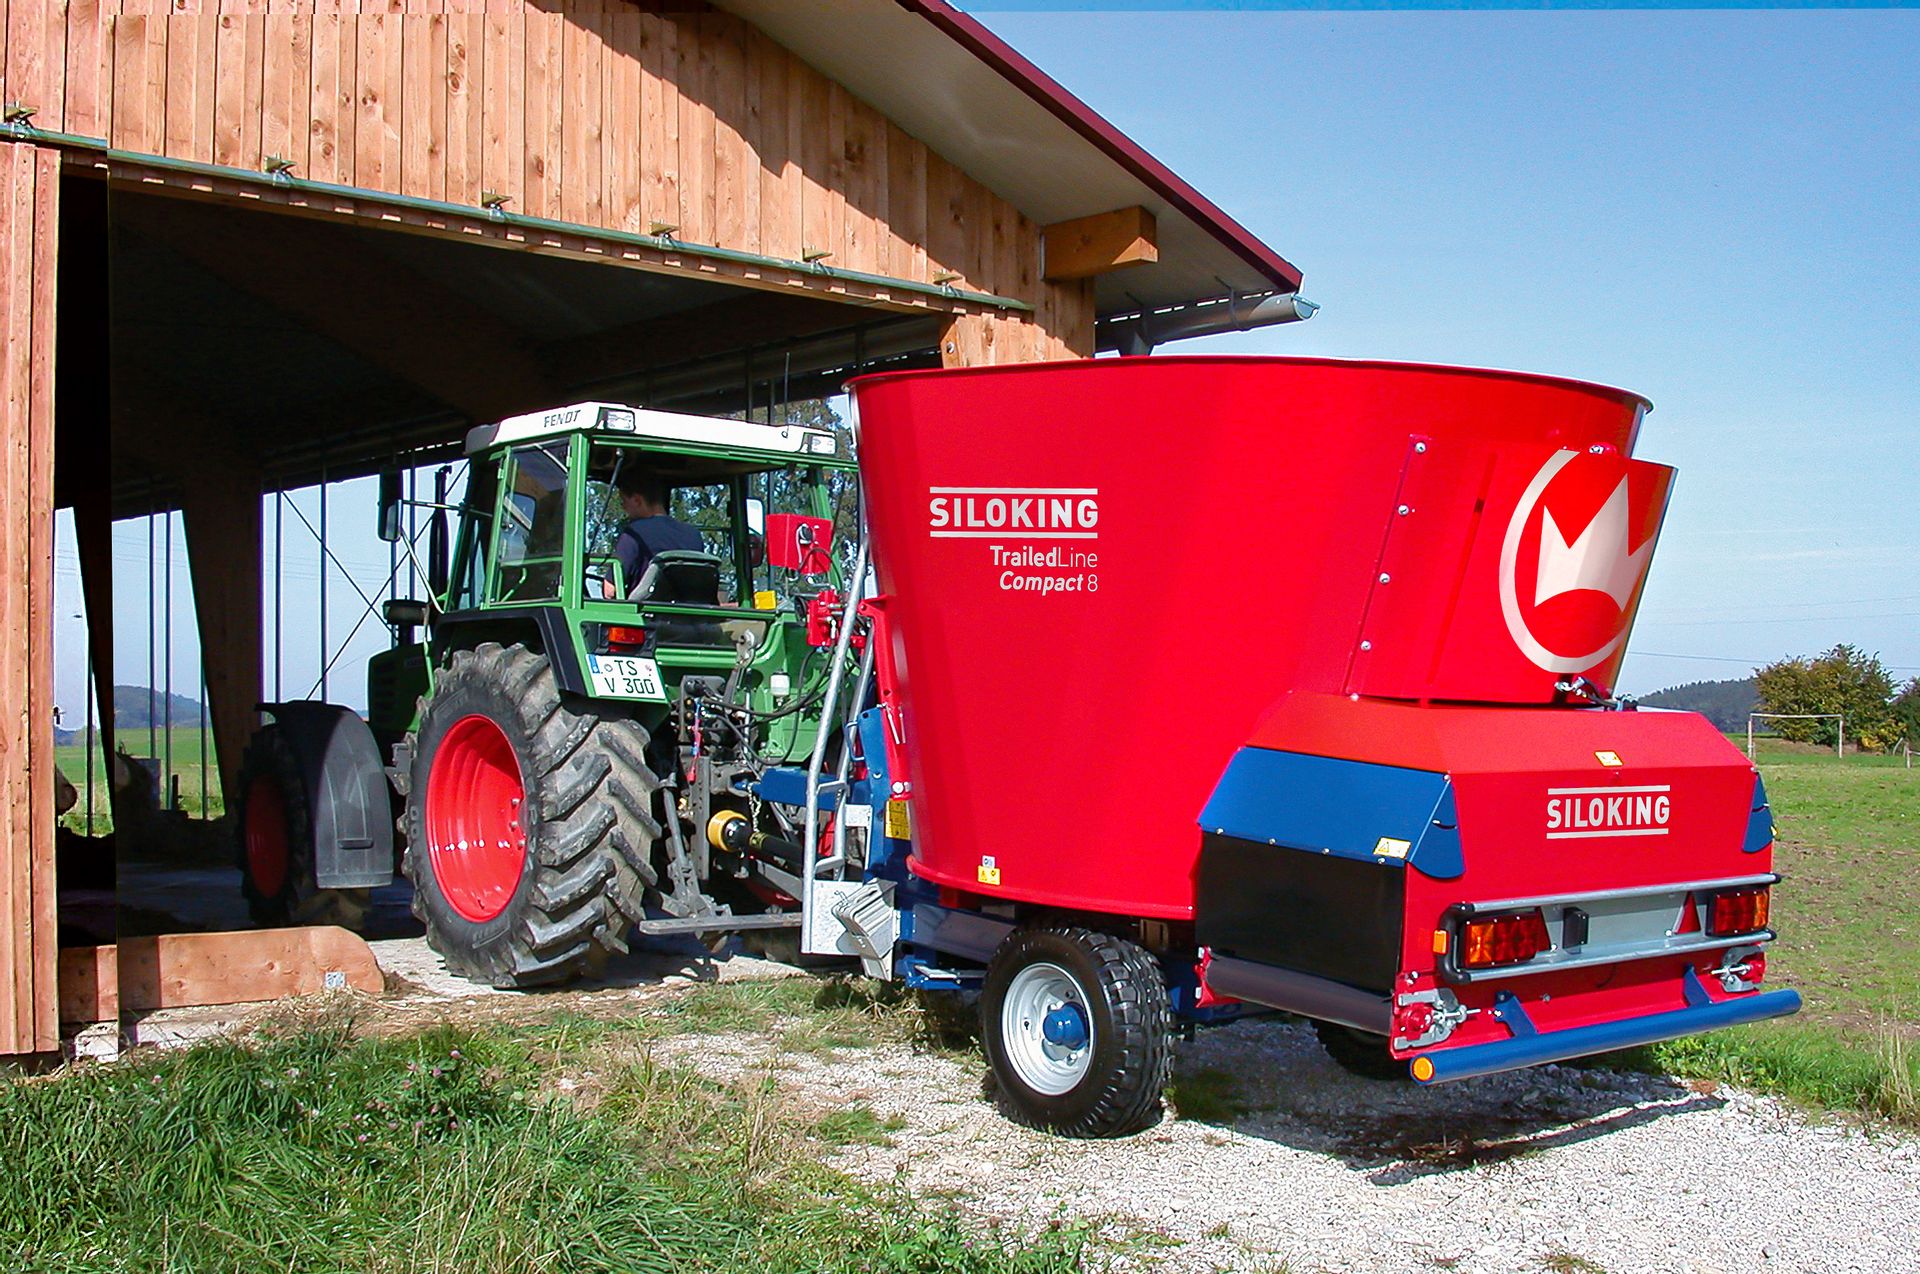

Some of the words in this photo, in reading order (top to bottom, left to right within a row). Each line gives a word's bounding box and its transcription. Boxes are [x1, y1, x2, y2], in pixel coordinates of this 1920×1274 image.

[544, 410, 581, 428] FENDT
[929, 497, 1099, 528] SILOKING
[990, 545, 1098, 568] TrailedLine
[999, 570, 1084, 596] Compact
[1087, 574, 1098, 592] 8
[614, 660, 638, 676] TS
[604, 677, 615, 693] V
[622, 678, 656, 694] 300
[1546, 795, 1670, 829] SILOKING
